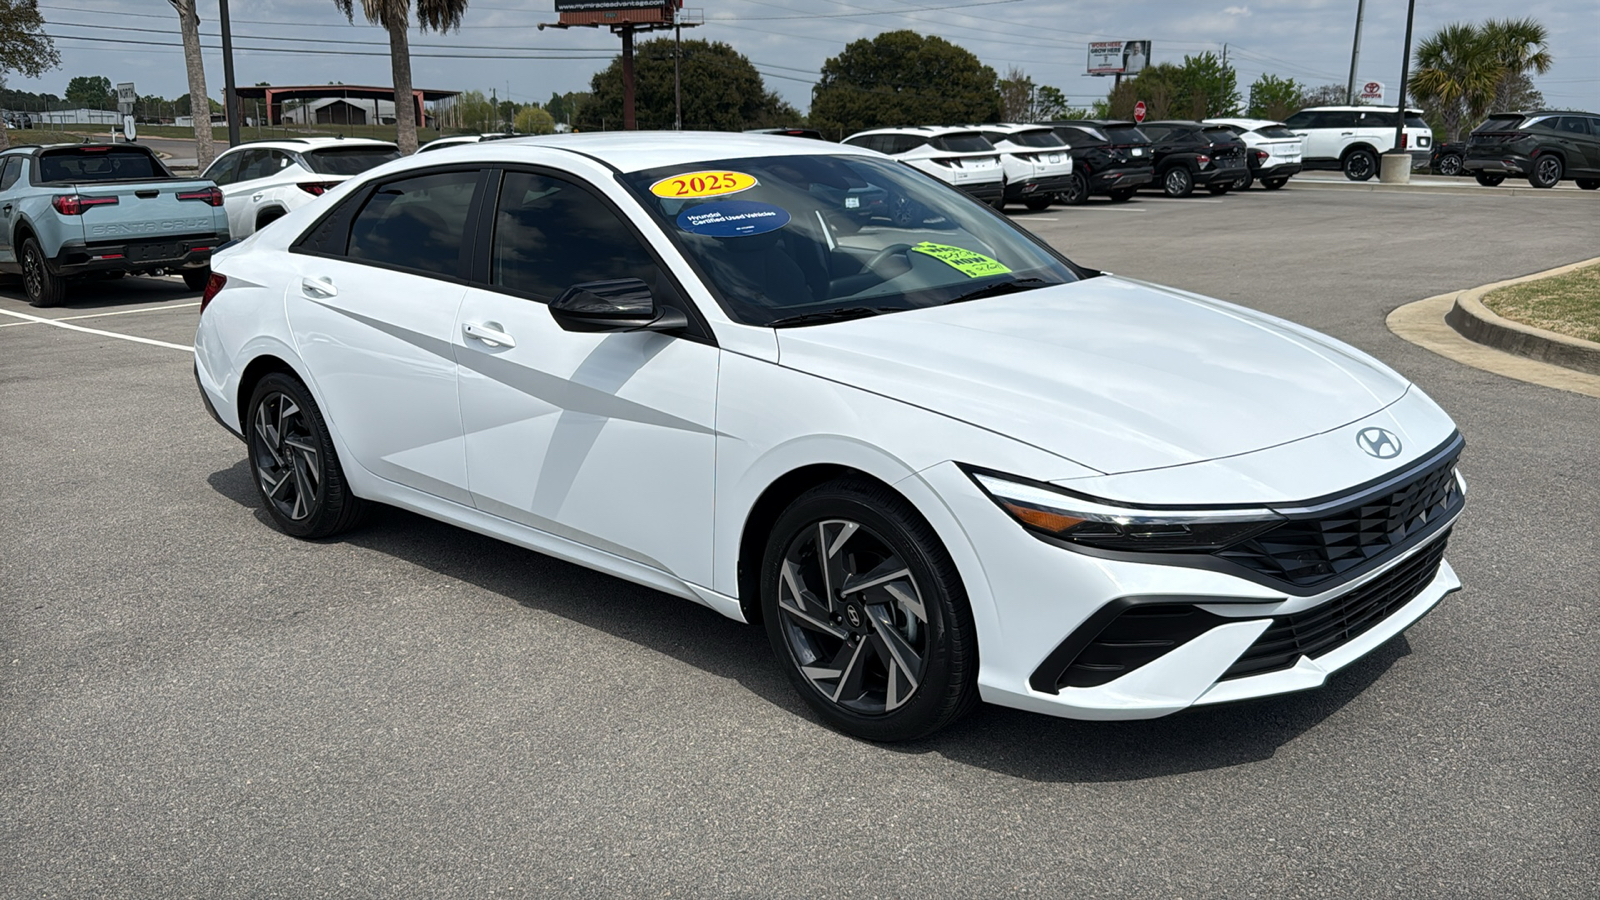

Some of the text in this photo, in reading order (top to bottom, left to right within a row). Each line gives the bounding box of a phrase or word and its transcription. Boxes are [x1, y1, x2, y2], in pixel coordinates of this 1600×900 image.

[558, 0, 665, 10] www.mymiracleadvantage.com
[119, 88, 134, 98] NORTH
[1134, 107, 1146, 116] STOP
[672, 173, 737, 196] 2025
[687, 211, 721, 222] Hyundai
[692, 211, 776, 226] Certified Used Vehicles
[92, 218, 208, 235] SANTA CRUZ
[950, 257, 987, 265] NOW
